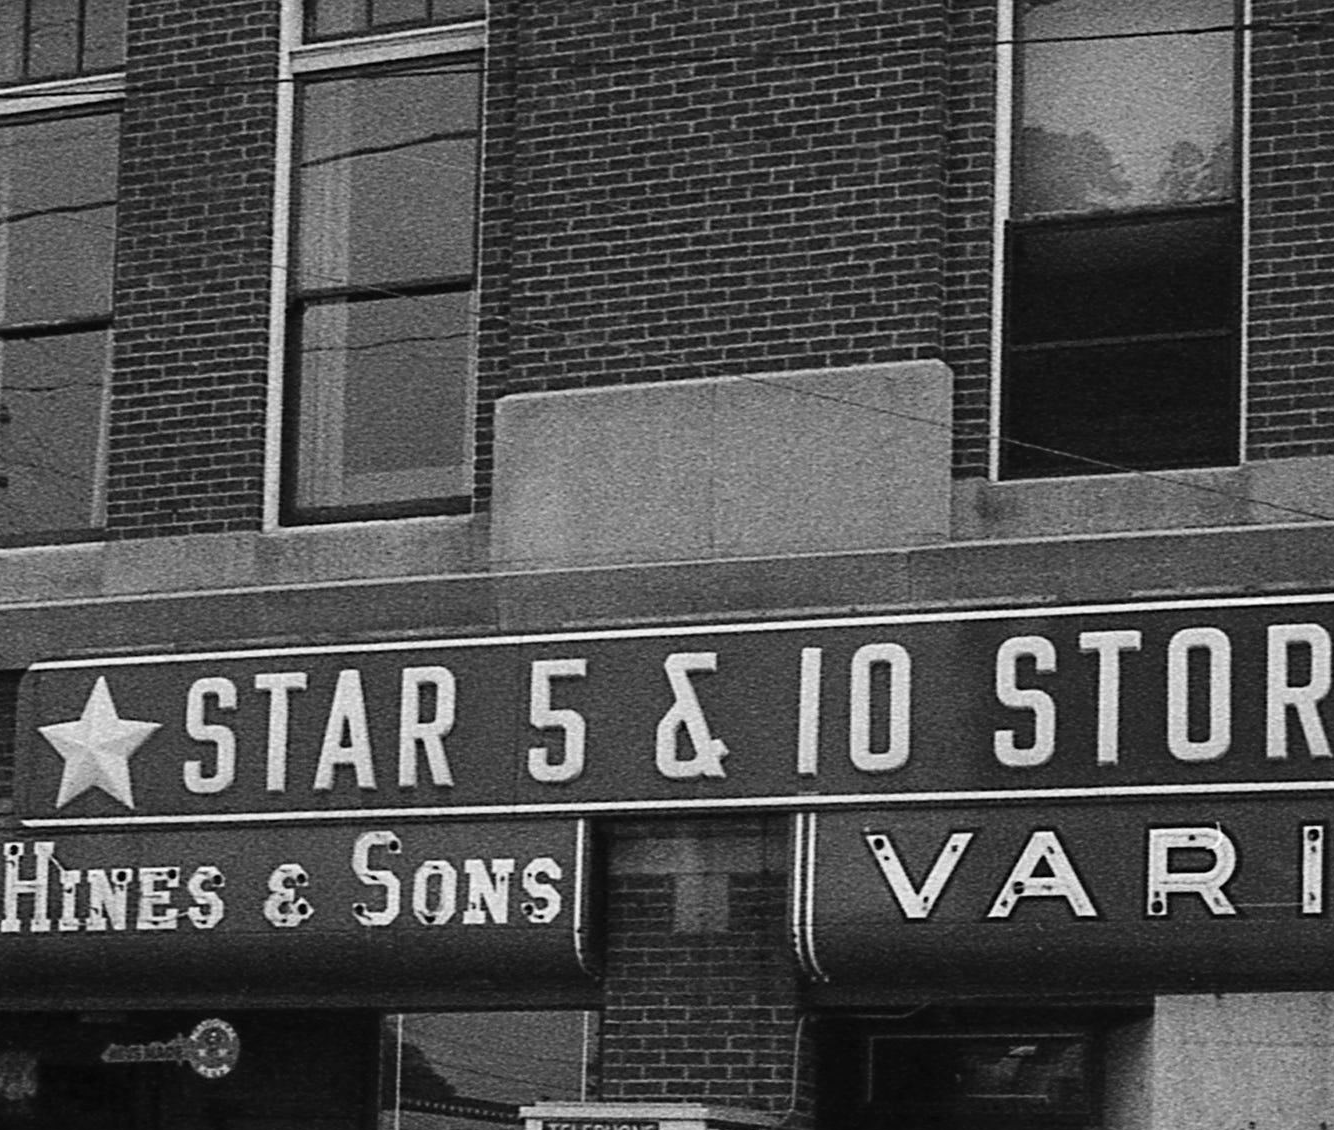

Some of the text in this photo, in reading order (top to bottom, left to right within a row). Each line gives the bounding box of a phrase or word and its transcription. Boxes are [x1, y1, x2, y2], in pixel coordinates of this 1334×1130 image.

[183, 665, 456, 793] STAR
[527, 659, 587, 783] 5
[655, 651, 729, 778] &
[798, 642, 912, 775] 10
[1, 840, 225, 933] HINES
[263, 863, 315, 929] &
[351, 830, 564, 929] SONS
